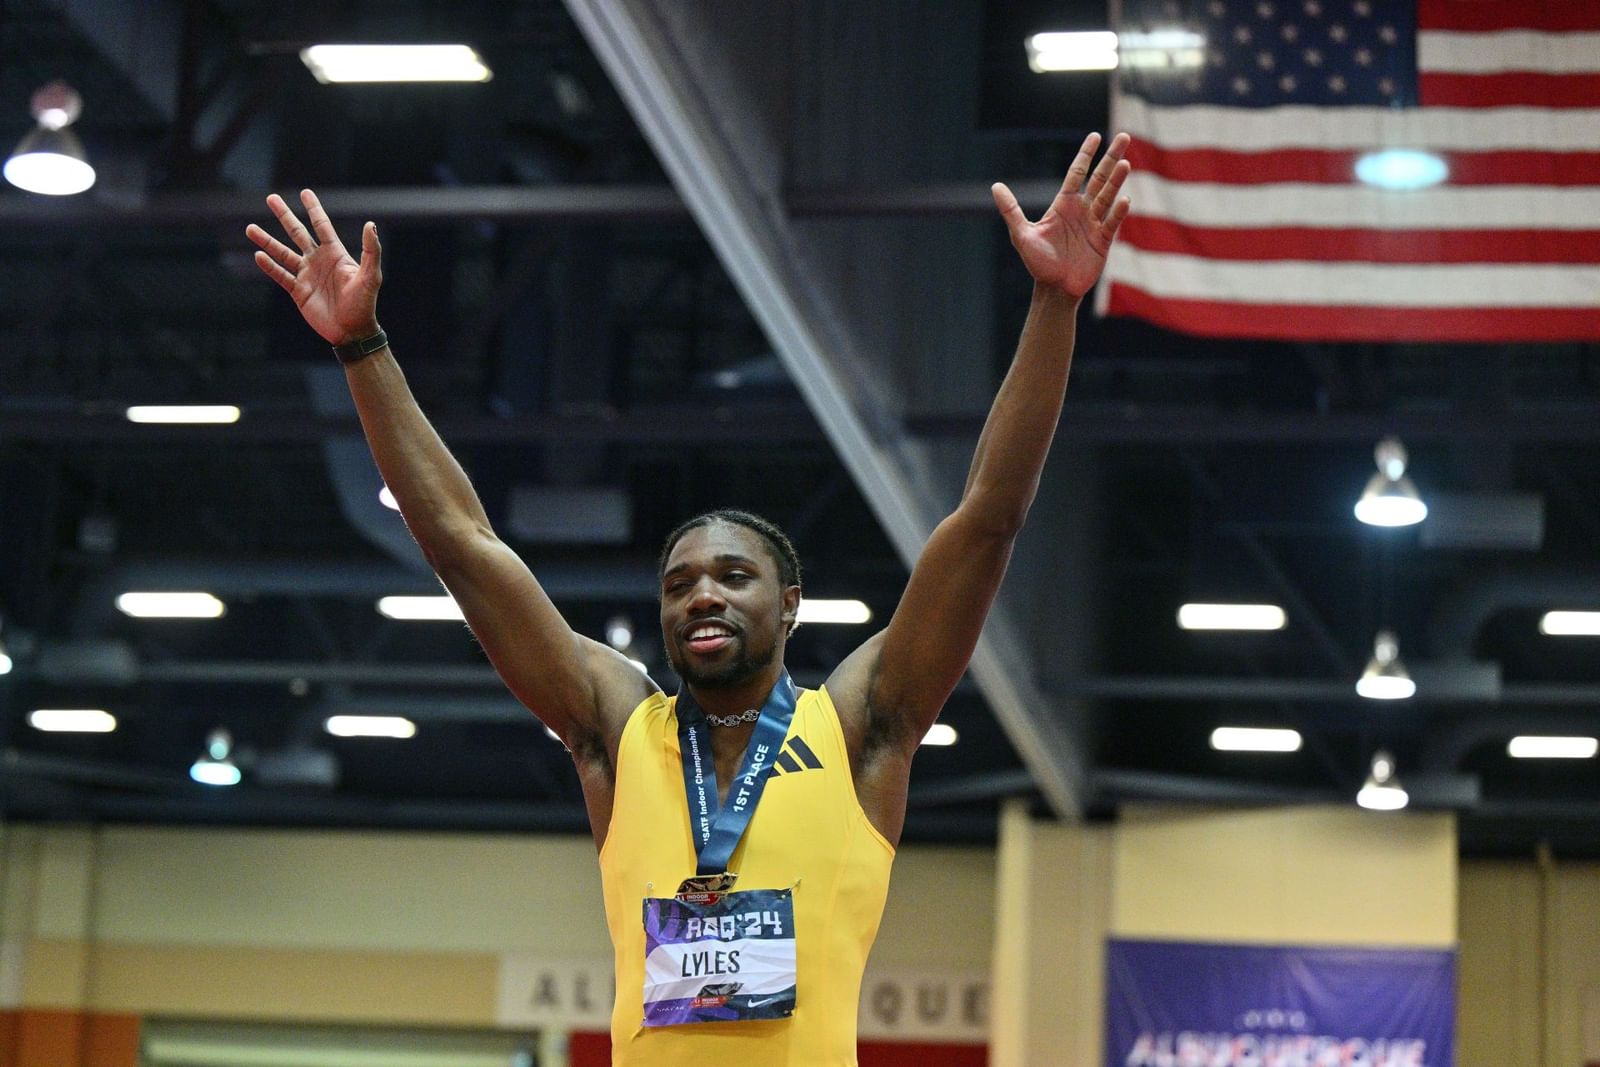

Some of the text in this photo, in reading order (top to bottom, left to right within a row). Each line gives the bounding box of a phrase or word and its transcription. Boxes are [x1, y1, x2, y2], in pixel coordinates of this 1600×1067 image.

[688, 726, 703, 785] Championships
[733, 743, 770, 813] 1ST PLACE
[696, 787, 708, 815] Indoor
[681, 950, 741, 977] LYLES
